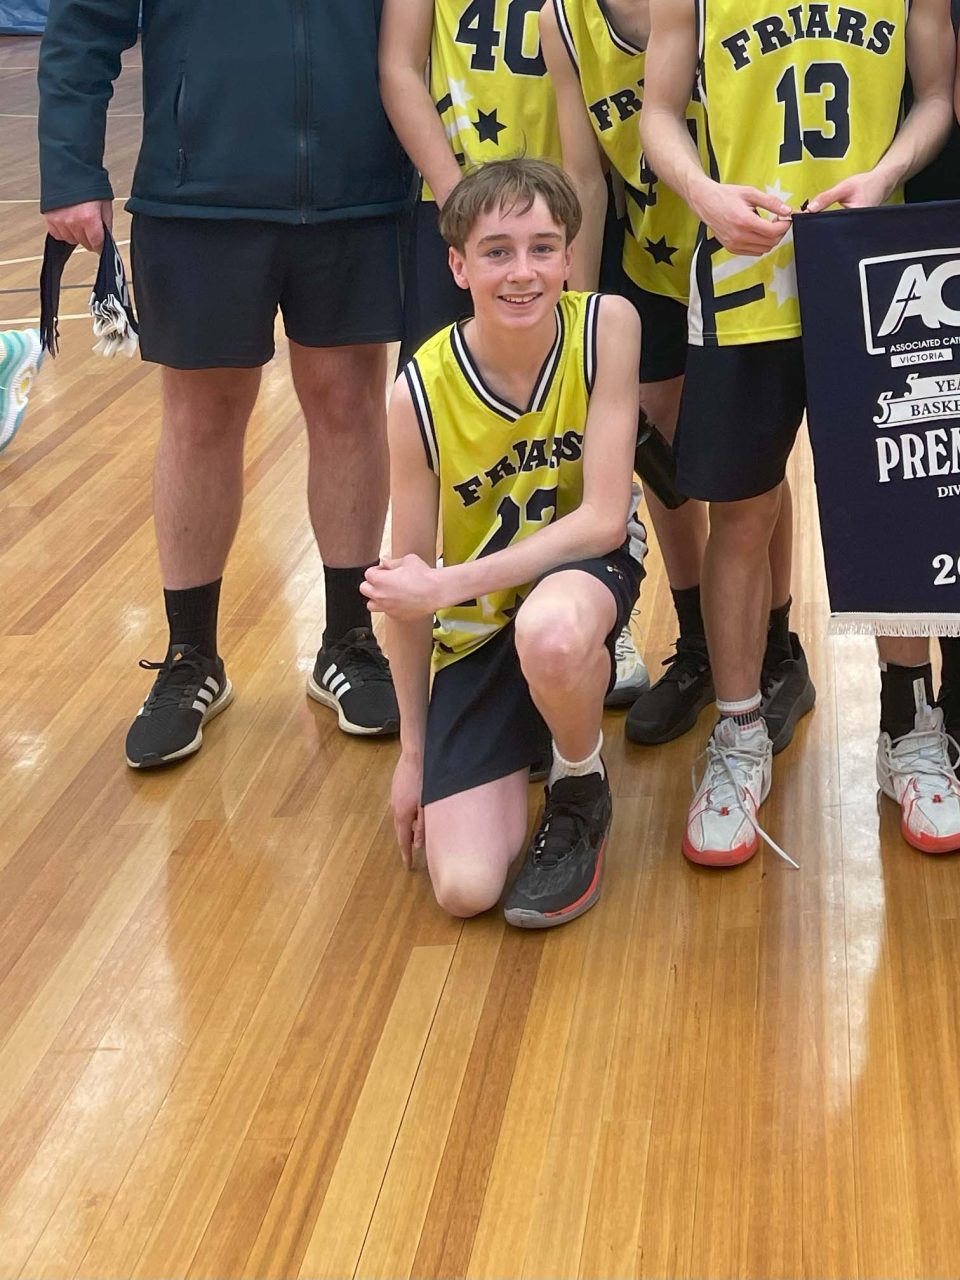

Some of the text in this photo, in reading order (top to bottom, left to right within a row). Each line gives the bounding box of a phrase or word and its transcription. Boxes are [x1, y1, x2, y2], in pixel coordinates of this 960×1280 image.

[720, 3, 896, 71] FRIARS
[775, 62, 850, 166] 13
[890, 338, 941, 353] ASSOCIATED
[899, 351, 944, 364] VICTORIA
